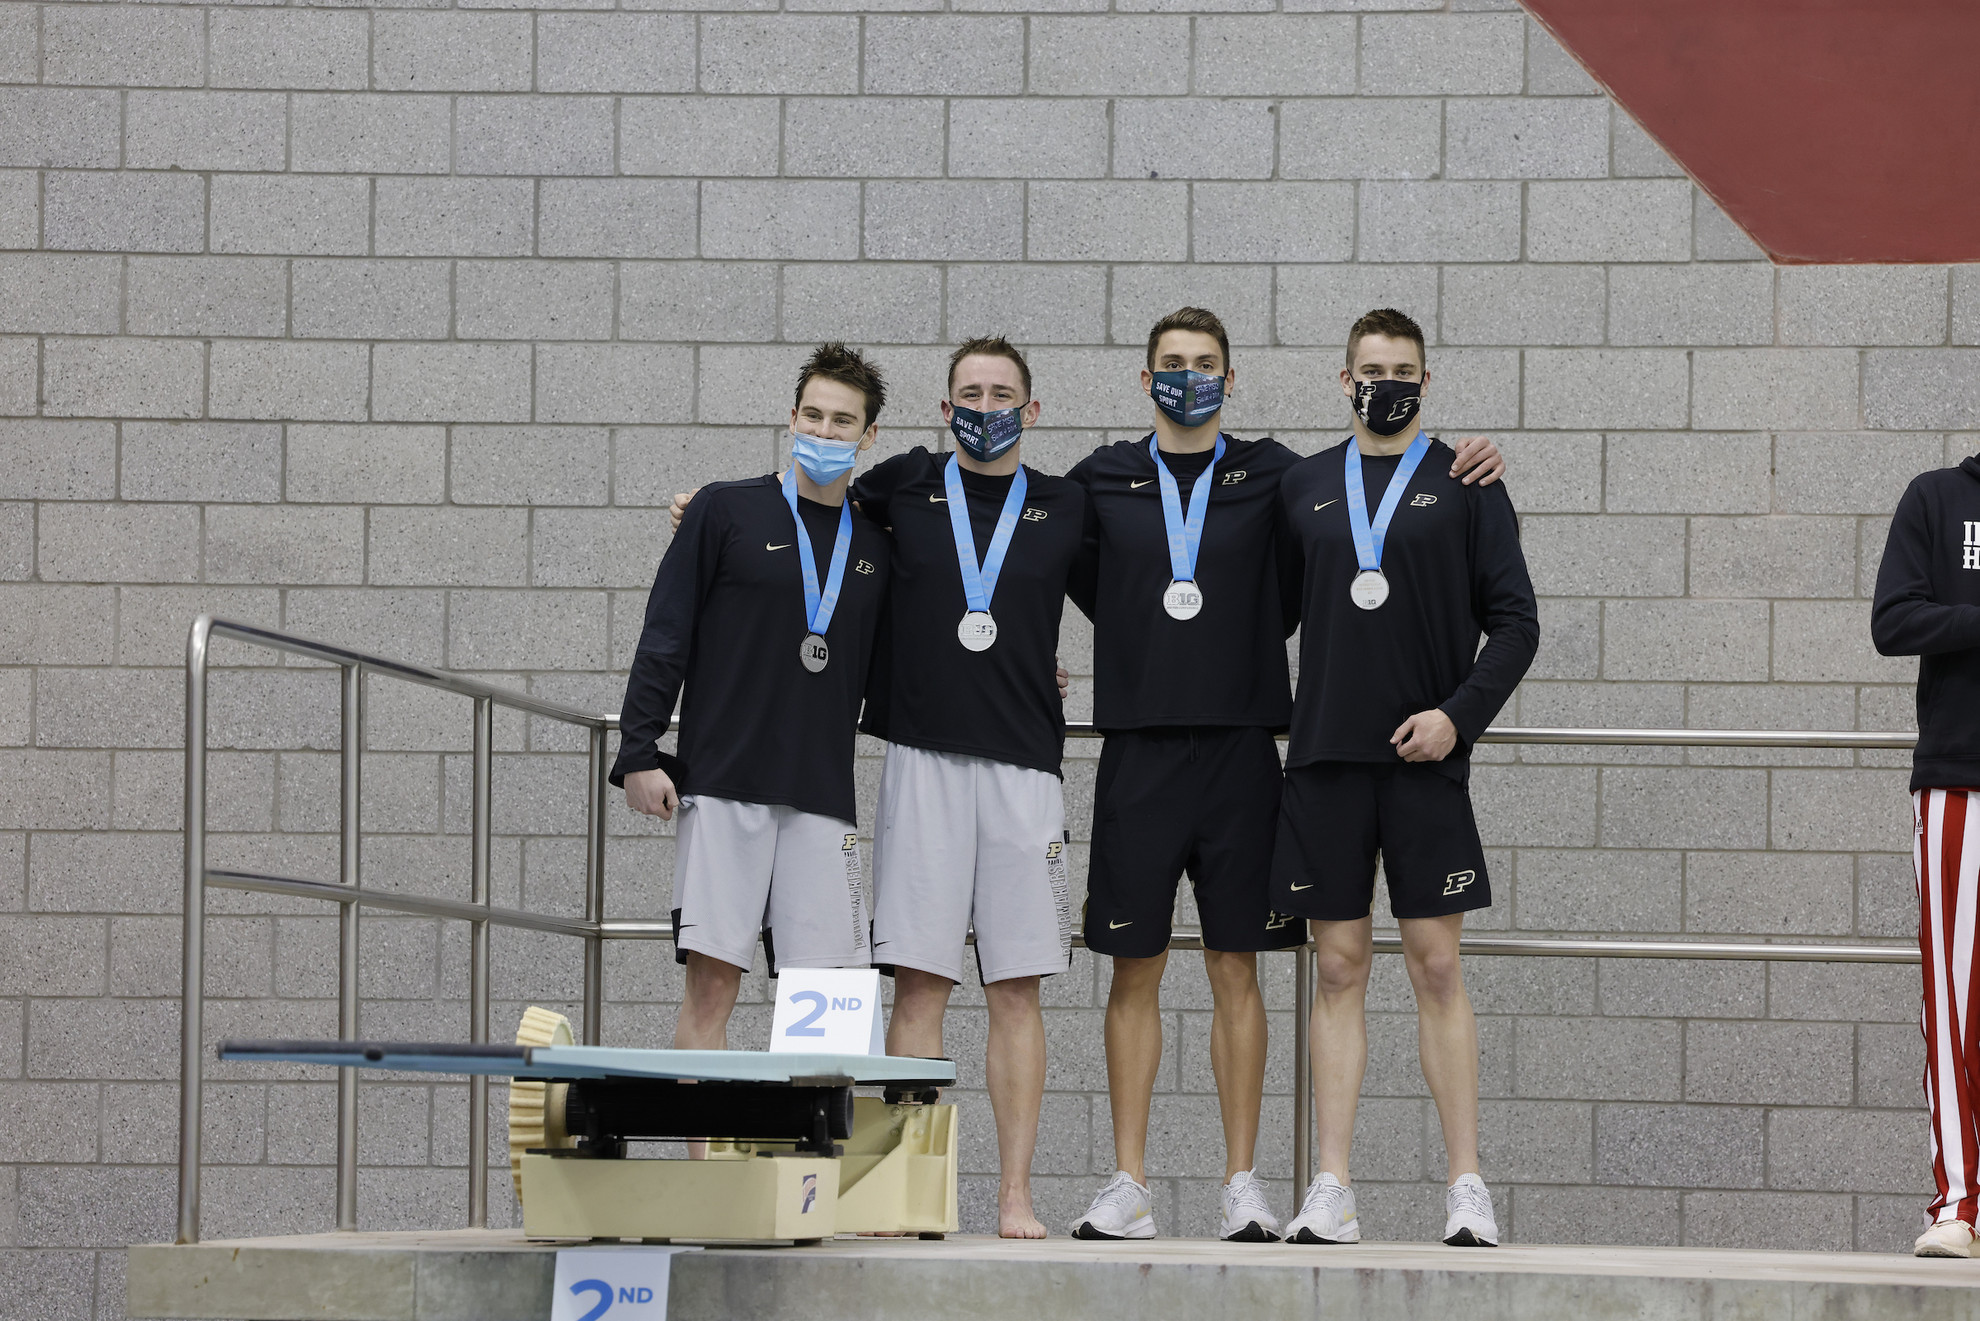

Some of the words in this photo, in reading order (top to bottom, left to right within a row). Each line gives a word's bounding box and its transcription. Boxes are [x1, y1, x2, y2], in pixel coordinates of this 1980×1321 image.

[1156, 382, 1169, 393] SAVE
[1170, 387, 1183, 398] OUR
[1158, 394, 1178, 408] SPORT
[956, 416, 972, 430] SAVE
[974, 425, 982, 436] OU
[959, 430, 978, 446] SPORT
[1222, 470, 1246, 485] P
[1410, 494, 1438, 507] P
[1022, 508, 1048, 522] P
[855, 559, 874, 575] P
[842, 834, 857, 850] P
[1046, 842, 1062, 858] P
[1443, 870, 1476, 896] P
[785, 990, 862, 1037] 2ND
[569, 1278, 654, 1321] 2ND
